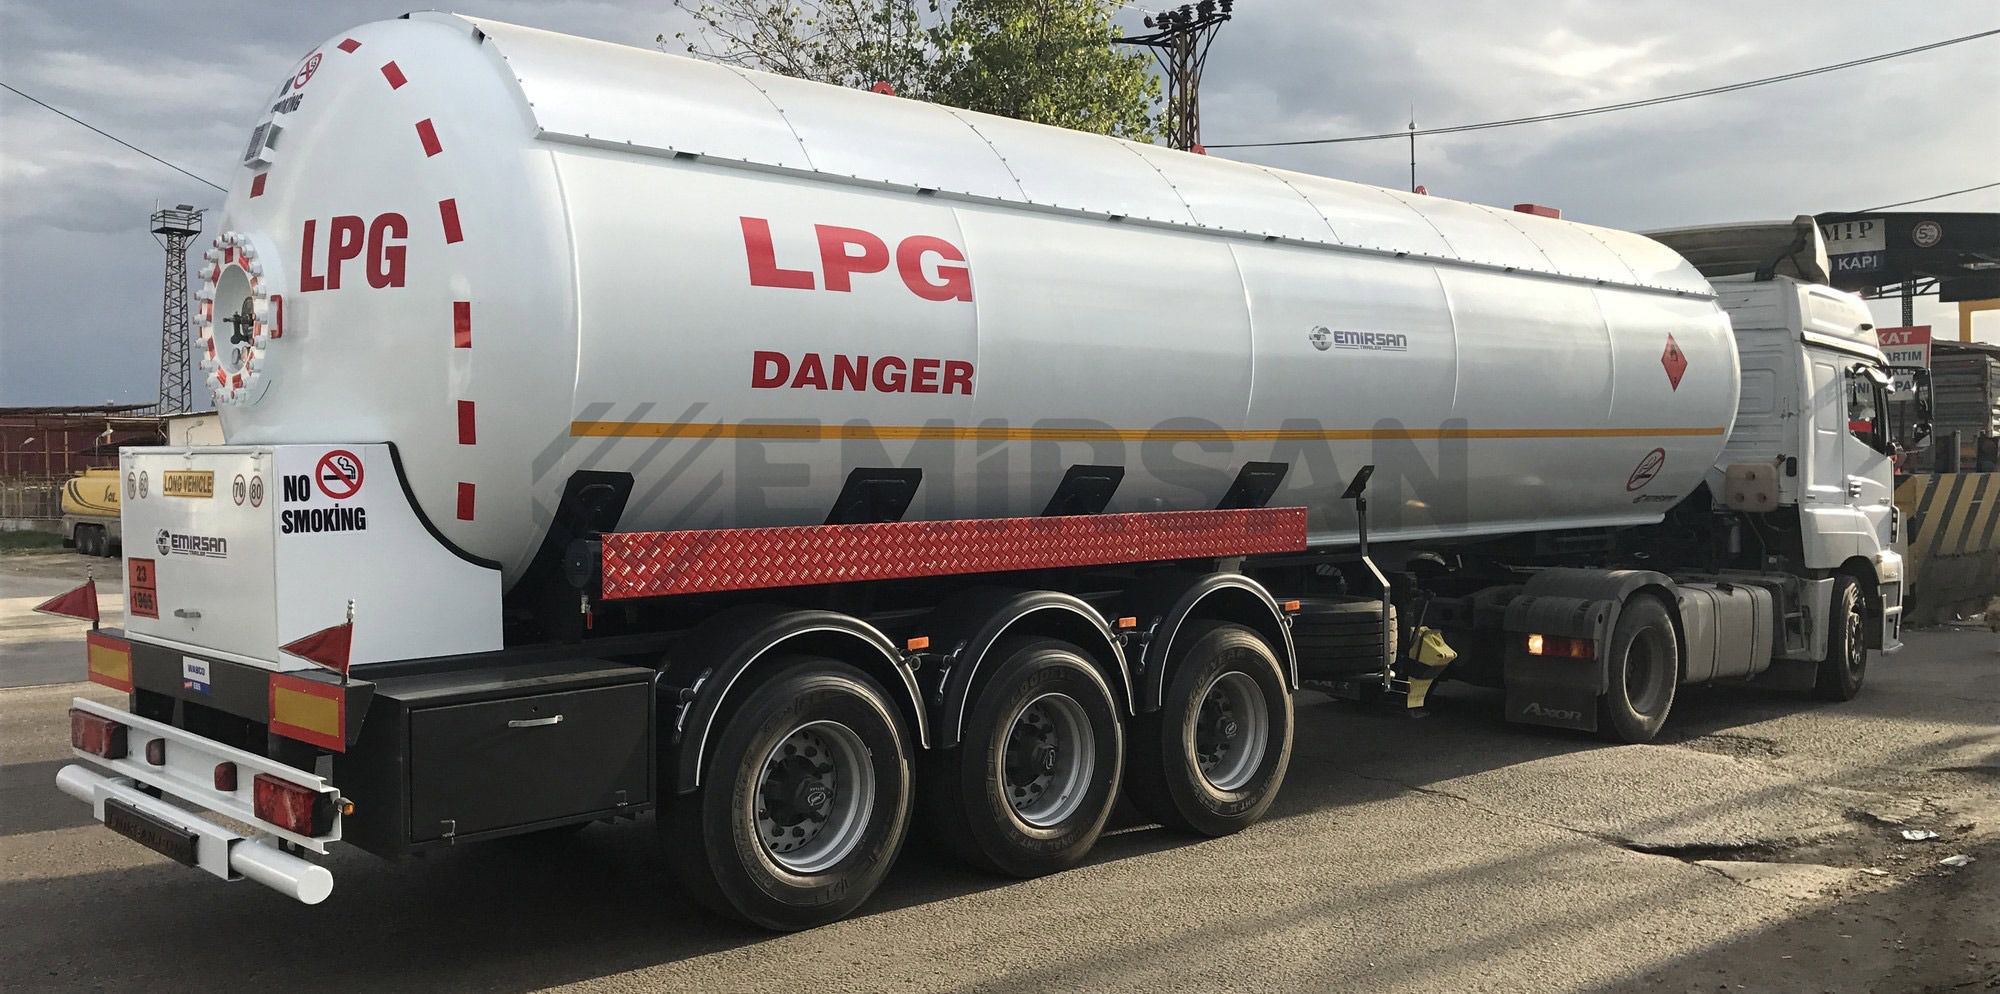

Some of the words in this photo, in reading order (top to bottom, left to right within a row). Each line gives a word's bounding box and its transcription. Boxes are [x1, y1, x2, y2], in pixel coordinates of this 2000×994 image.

[300, 212, 408, 292] LPG
[739, 215, 973, 302] LPG
[1838, 255, 1877, 271] KAPI
[1333, 330, 1407, 347] EMIRSAN
[751, 350, 974, 395] DANGER
[164, 473, 183, 493] LONG
[183, 475, 213, 494] VEHICLE
[234, 481, 244, 498] 70
[251, 484, 262, 500] 80
[283, 474, 311, 502] NO
[171, 534, 227, 553] EMIRSAN
[135, 565, 147, 583] 23
[187, 663, 206, 676] WABCO
